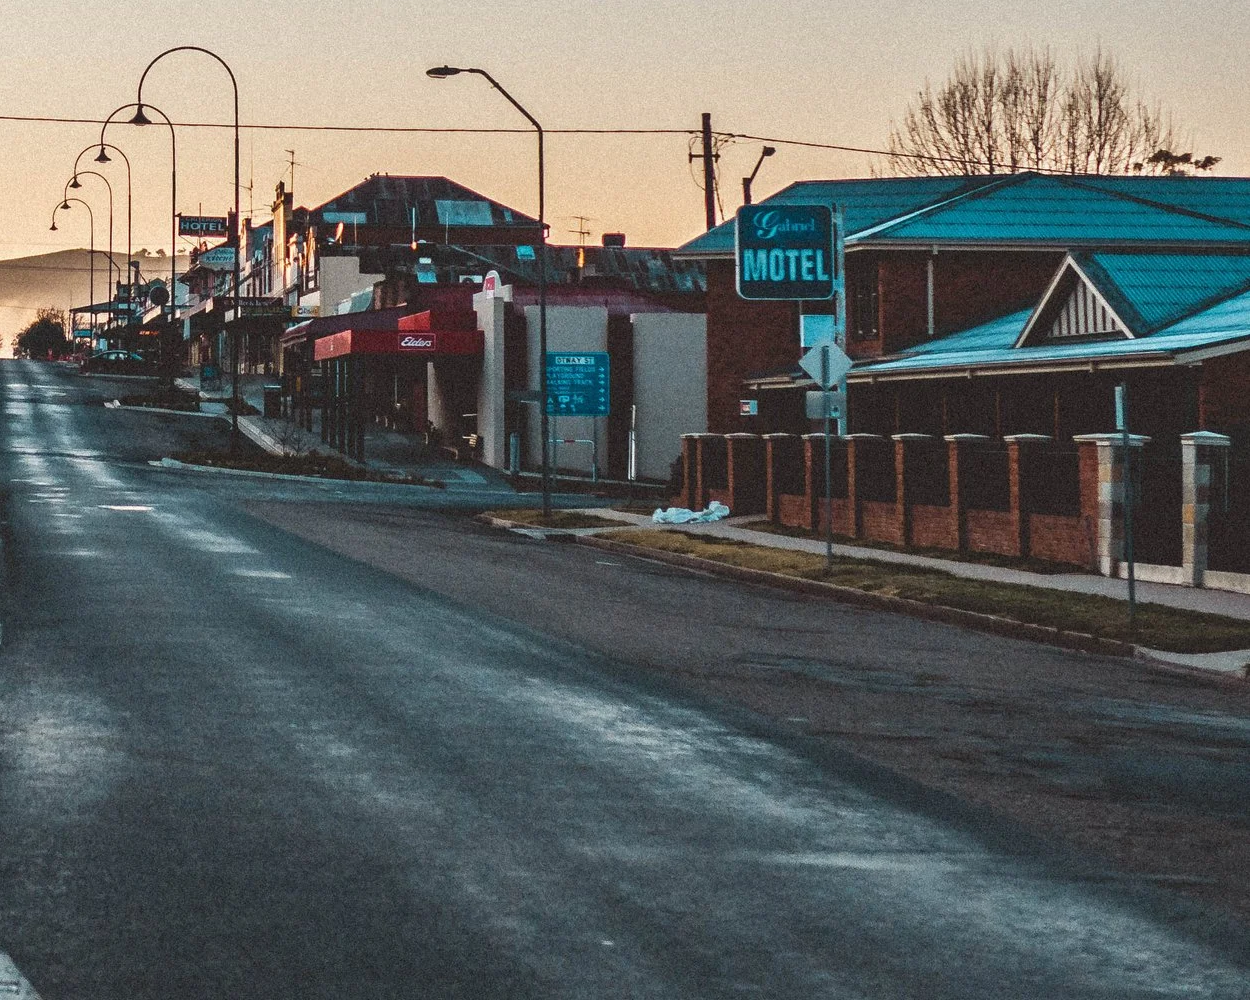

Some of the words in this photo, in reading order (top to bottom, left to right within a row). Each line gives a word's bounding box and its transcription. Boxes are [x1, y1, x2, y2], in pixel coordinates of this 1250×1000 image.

[180, 221, 225, 231] HOTEL
[753, 210, 815, 239] Gabriel
[743, 247, 829, 281] MOTEL
[400, 336, 432, 347] Elders
